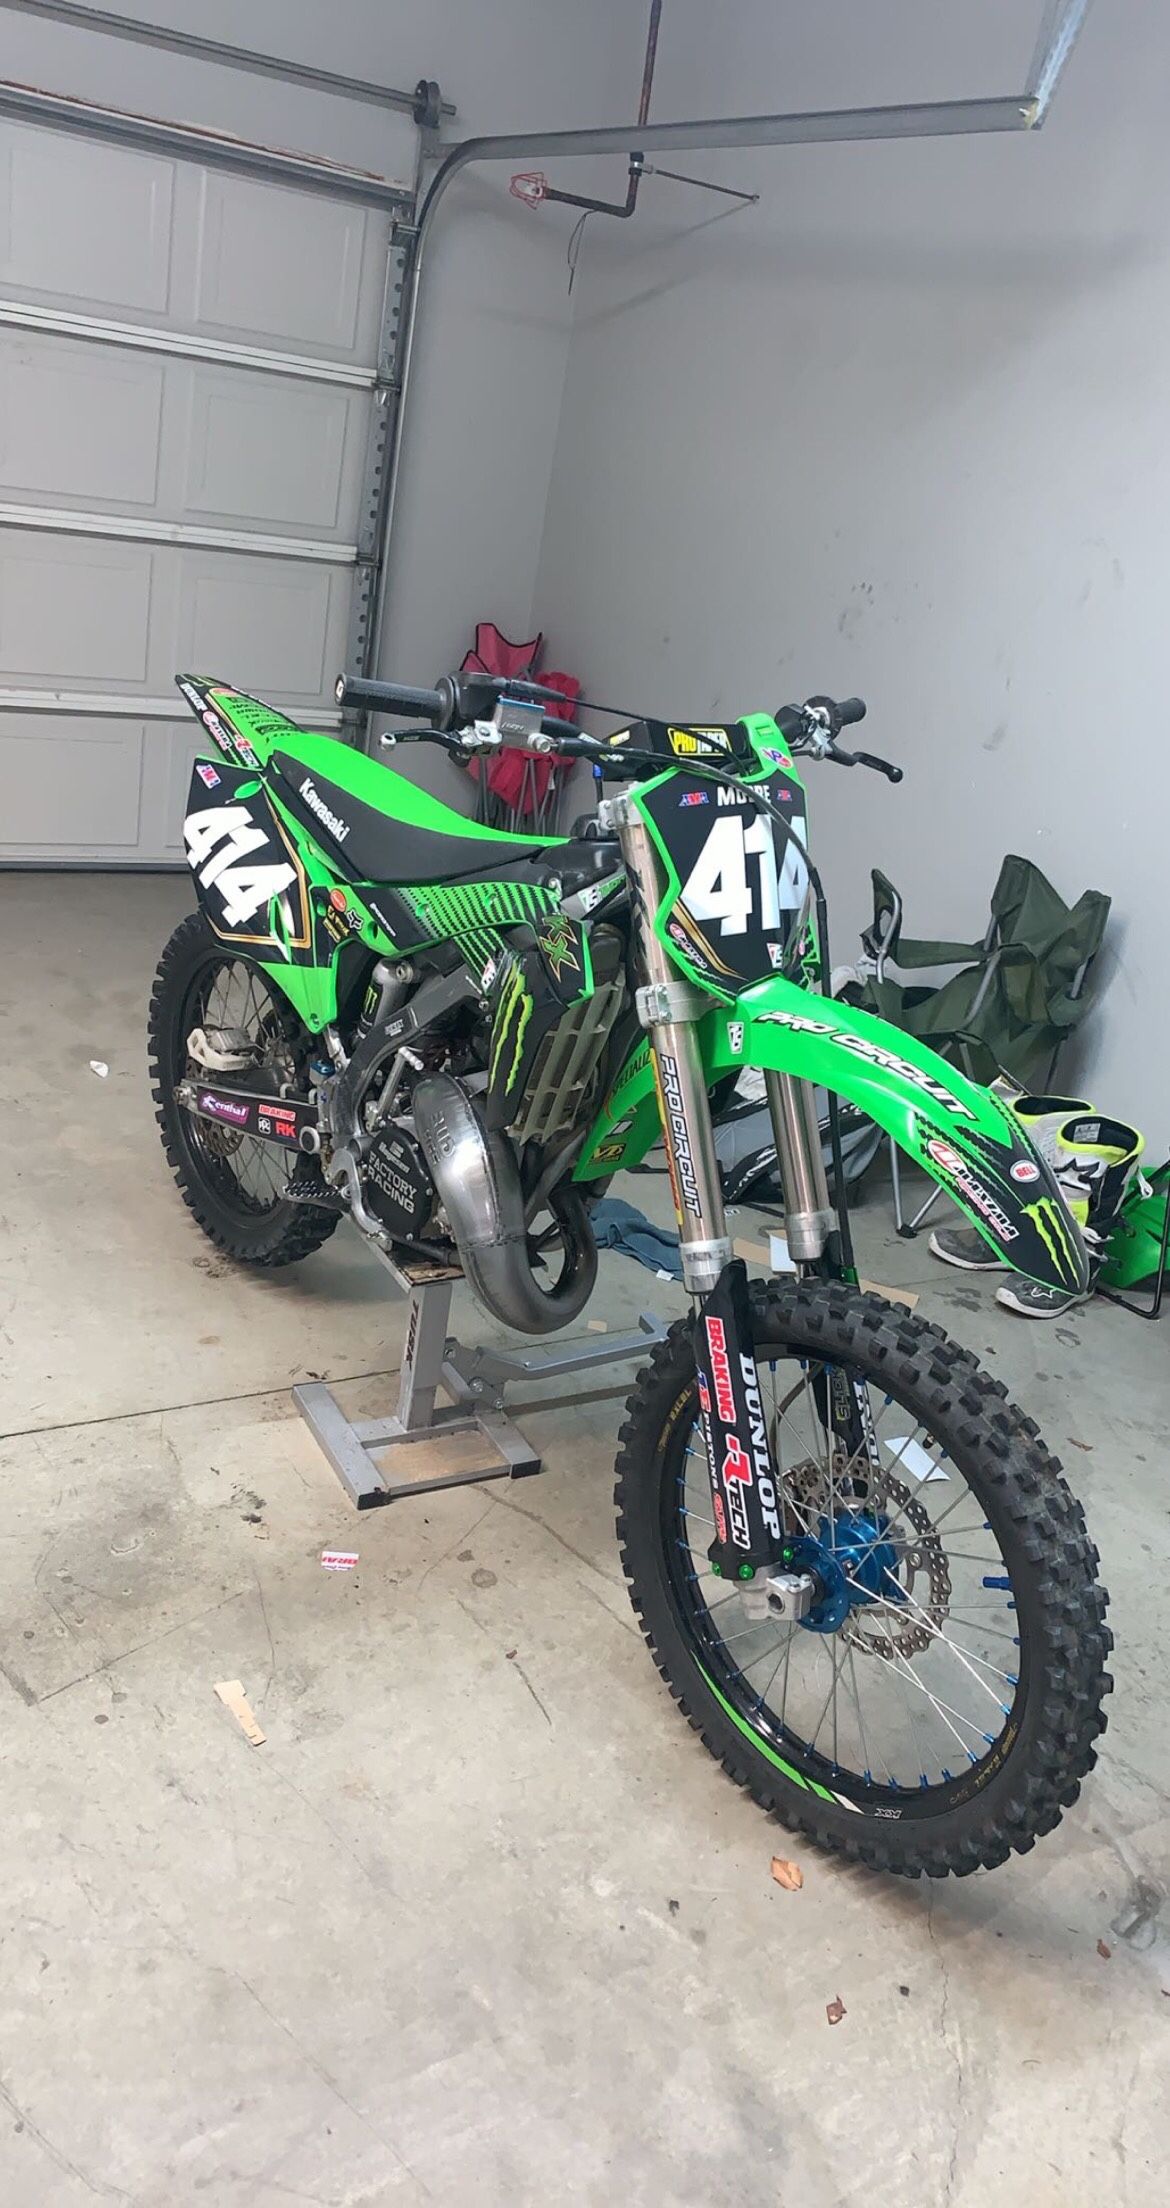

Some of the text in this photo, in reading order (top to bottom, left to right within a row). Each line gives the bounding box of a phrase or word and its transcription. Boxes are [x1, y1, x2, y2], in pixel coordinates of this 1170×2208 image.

[299, 778, 351, 843] Kawasaki
[717, 784, 771, 806] MORE
[183, 806, 298, 927] 414
[679, 813, 809, 936] 414
[660, 1053, 684, 1114] PRO
[754, 1010, 980, 1121] PRO CIRCUIT
[202, 1094, 248, 1120] Renthal
[258, 1104, 296, 1121] BRAKING
[275, 1121, 296, 1137] RK
[368, 1151, 417, 1199] FACTORY
[368, 1165, 415, 1214] RACING
[670, 1112, 701, 1218] CIRCUIT
[1015, 1164, 1037, 1178] BELL
[705, 1316, 737, 1424] BRAKING
[702, 1411, 718, 1489] PISTONS
[739, 1352, 782, 1540] DUNLOP
